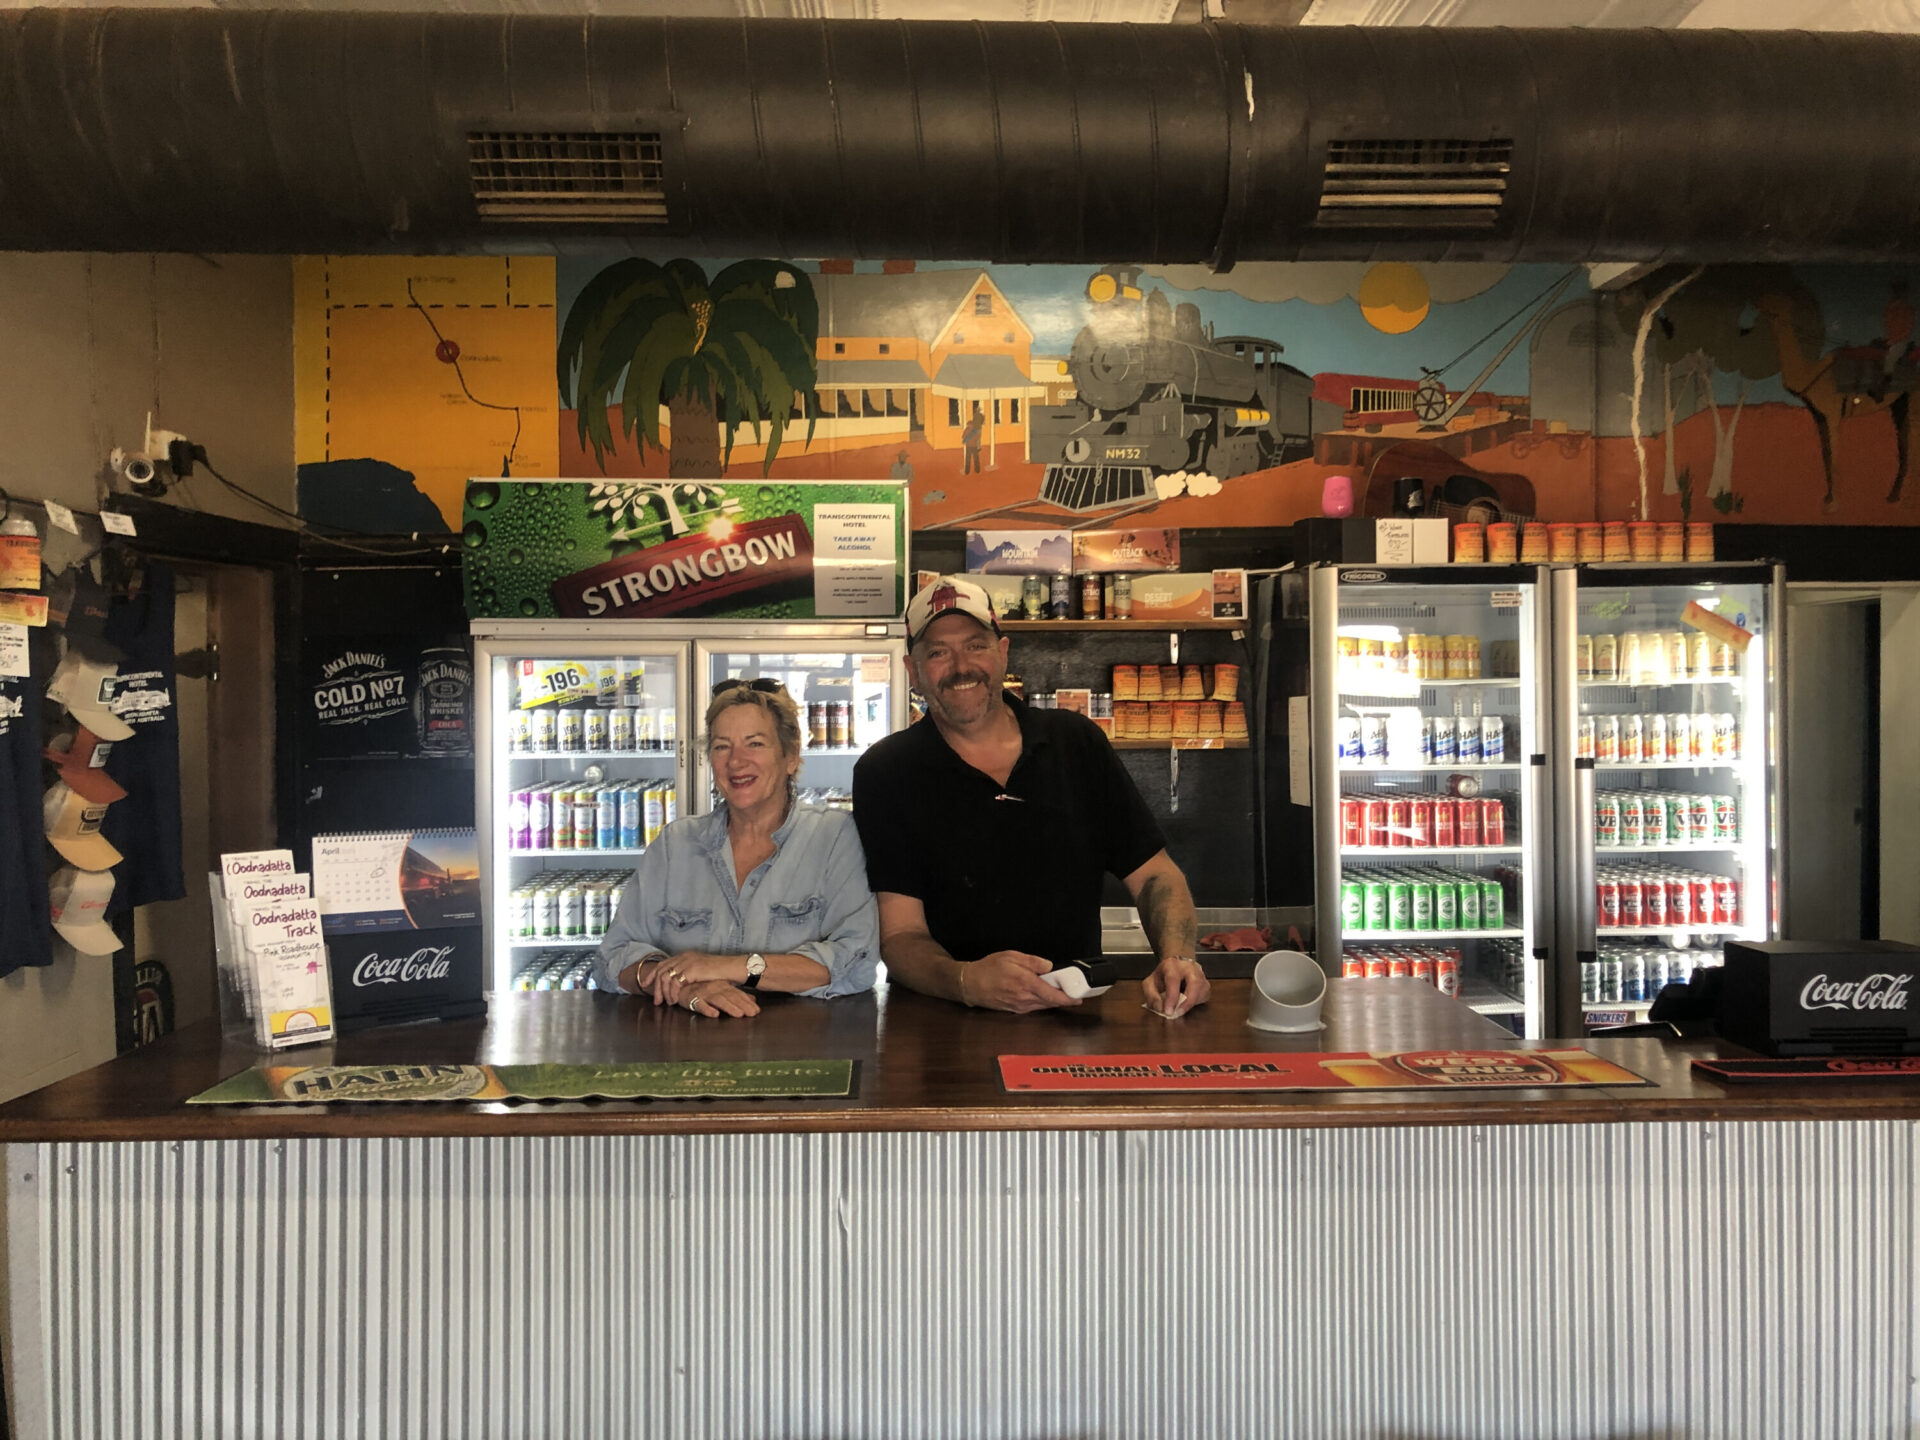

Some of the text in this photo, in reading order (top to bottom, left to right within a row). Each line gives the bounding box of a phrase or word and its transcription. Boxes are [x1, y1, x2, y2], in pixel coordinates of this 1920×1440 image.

[1105, 448, 1141, 459] NM32
[1002, 549, 1039, 559] MOUNTAIN
[1112, 547, 1144, 559] OUTBACK
[581, 531, 796, 616] STRONGBOW
[1144, 592, 1173, 602] DESERT
[321, 651, 386, 679] JACK DANIEL'S
[421, 667, 440, 687] JACK
[314, 684, 366, 710] COLD
[318, 710, 338, 720] REAL
[364, 701, 384, 712] REAL
[385, 696, 409, 707] COLD.
[321, 847, 340, 856] April
[232, 859, 292, 875] Oodnadatta
[244, 883, 306, 899] Oodnadatta
[252, 908, 317, 926] Oodnadatta
[282, 922, 318, 938] Track
[353, 946, 456, 987] Coca-Cola
[1800, 973, 1914, 1010] Coca-Cola
[1587, 1012, 1626, 1023] SNICKERS
[1159, 1063, 1293, 1073] LOCAL
[1414, 1057, 1518, 1065] WEST
[682, 1068, 732, 1078] the
[1439, 1066, 1525, 1074] END
[293, 1065, 464, 1095] HAHN
